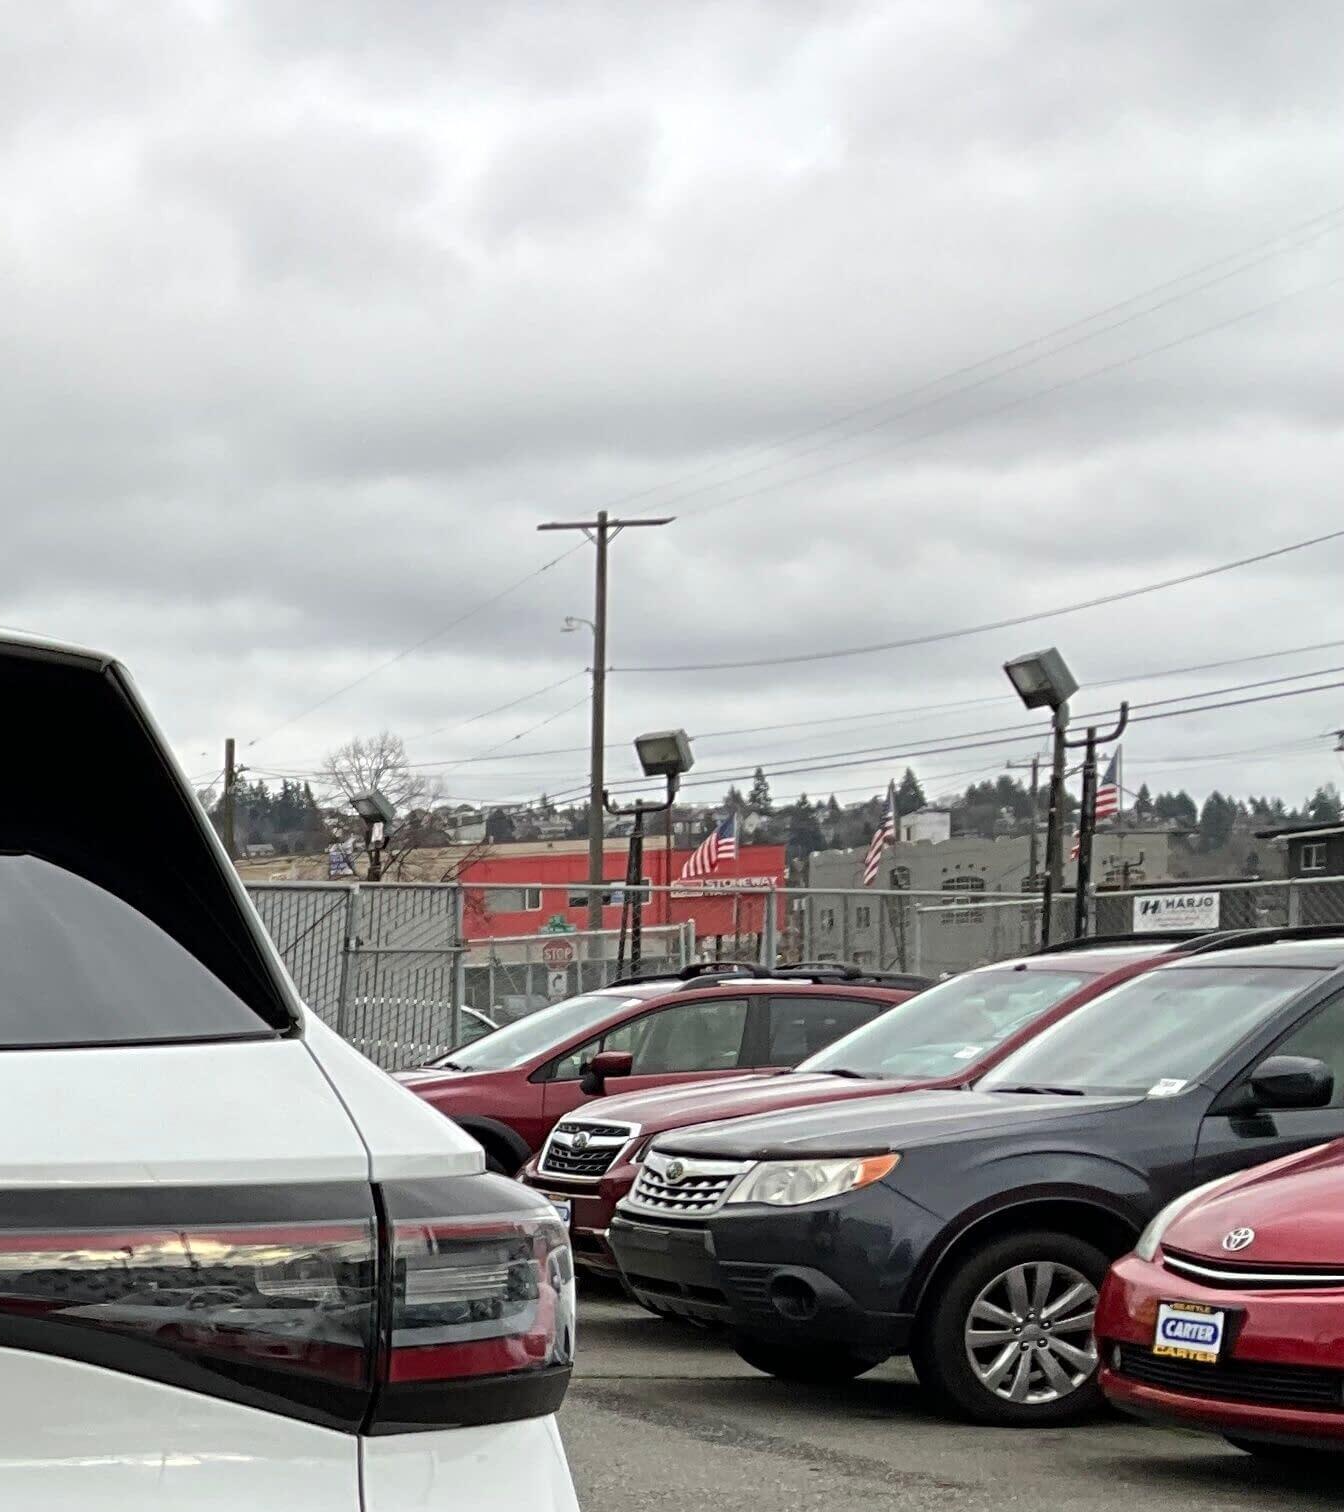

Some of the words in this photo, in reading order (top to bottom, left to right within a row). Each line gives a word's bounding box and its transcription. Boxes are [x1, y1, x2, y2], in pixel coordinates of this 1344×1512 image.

[1165, 897, 1214, 909] HARJO
[544, 947, 573, 961] STOP
[1165, 1319, 1215, 1342] CARTER
